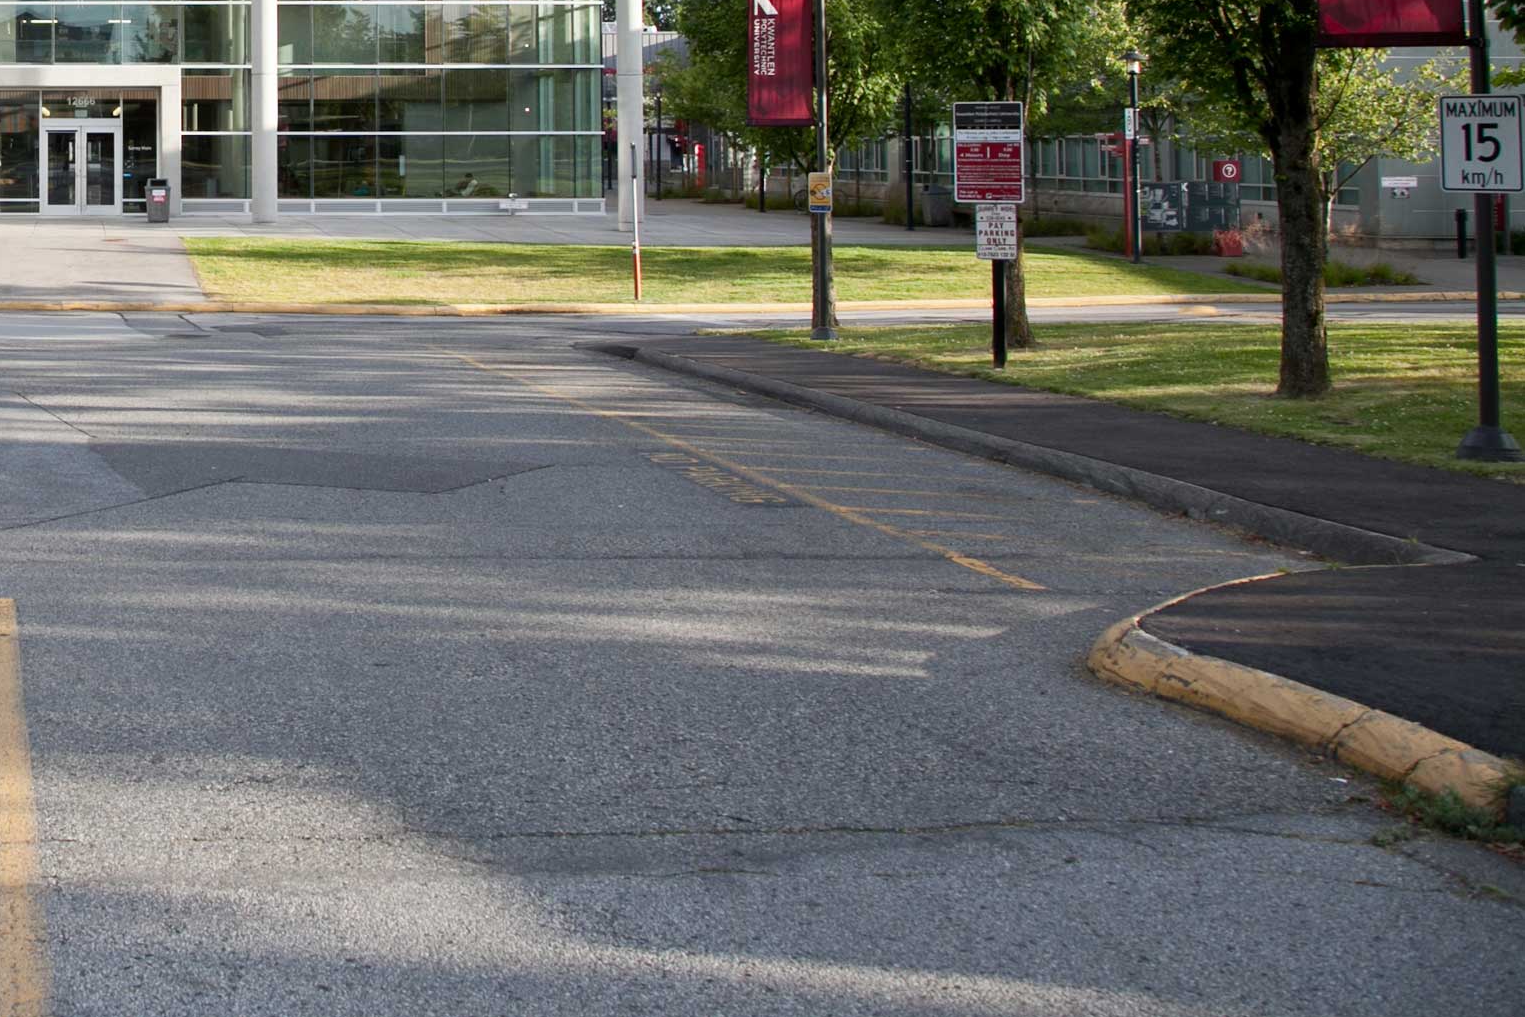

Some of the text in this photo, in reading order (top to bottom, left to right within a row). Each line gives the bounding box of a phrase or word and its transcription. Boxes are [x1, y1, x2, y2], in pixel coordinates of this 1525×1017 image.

[760, 18, 768, 76] POLYTECHNIC
[767, 18, 775, 76] KWANTLEN
[1446, 101, 1516, 117] MAXIMUM
[1461, 123, 1501, 163] 15
[1462, 167, 1504, 185] km/h
[978, 229, 1015, 237] PARKING
